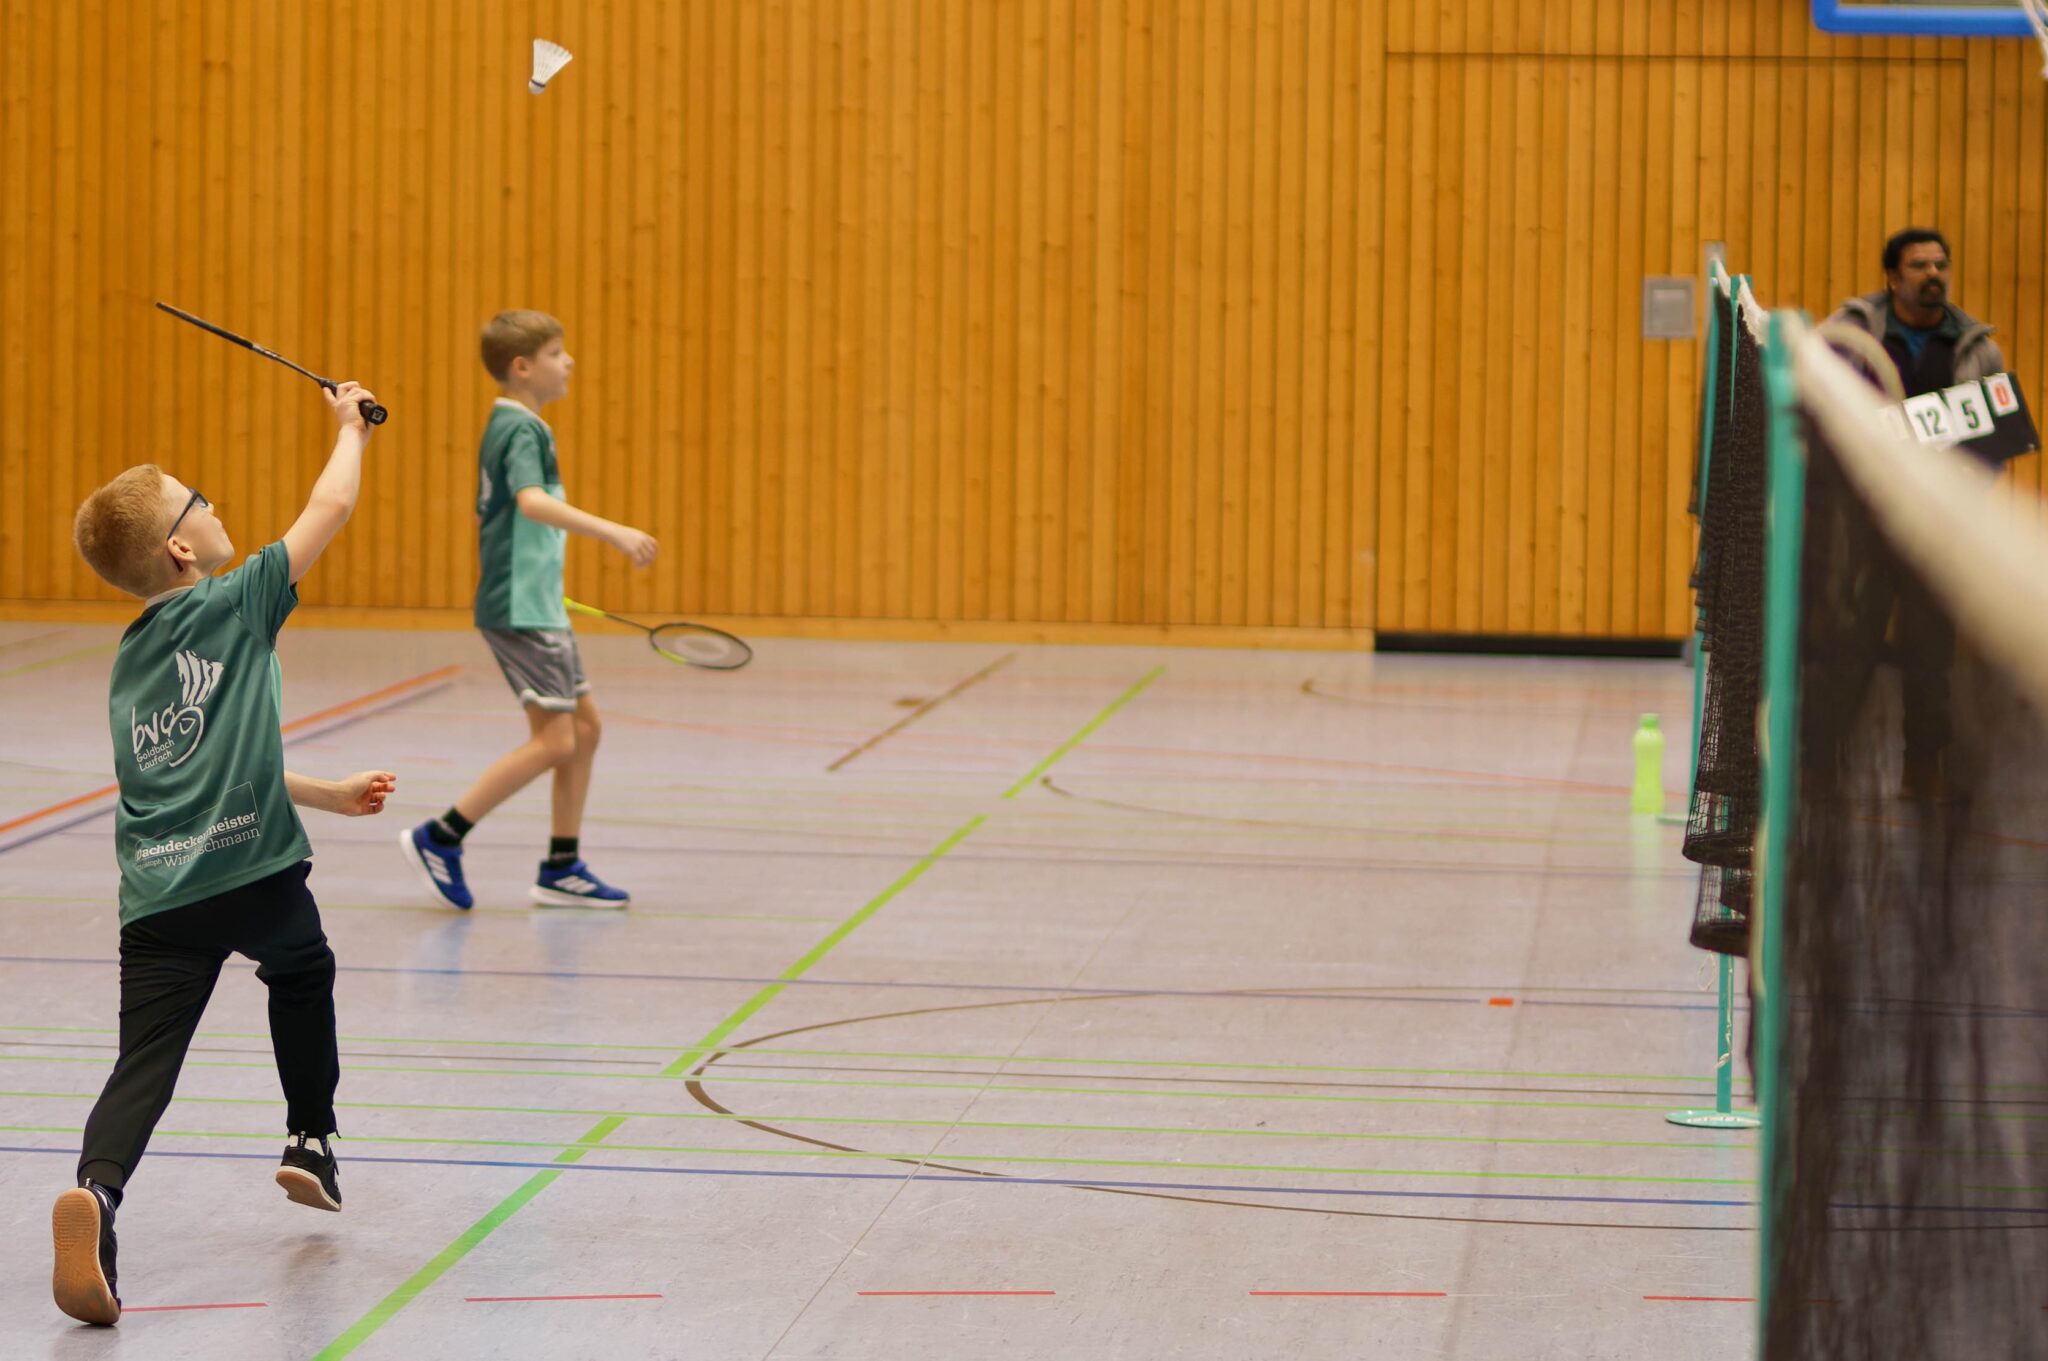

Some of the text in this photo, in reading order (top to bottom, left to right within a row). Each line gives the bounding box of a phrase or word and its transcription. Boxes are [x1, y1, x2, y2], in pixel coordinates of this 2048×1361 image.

[1916, 407, 1947, 437] 12
[1960, 399, 1981, 430] 5
[136, 738, 175, 763] Goldbach
[139, 750, 173, 772] Laufach
